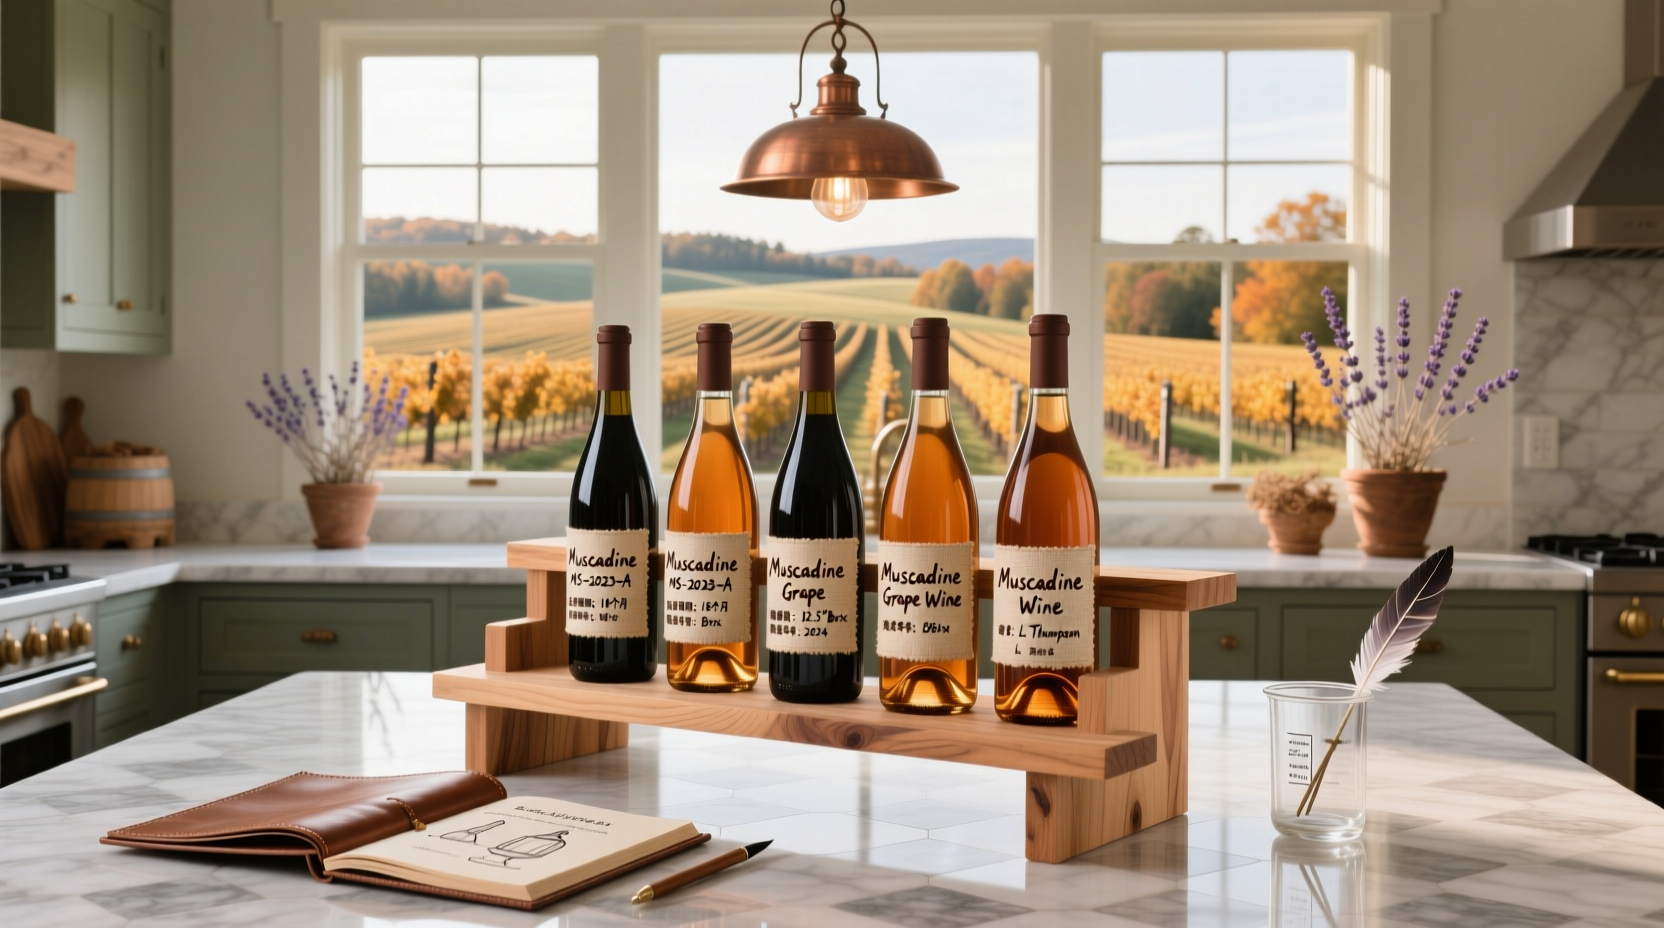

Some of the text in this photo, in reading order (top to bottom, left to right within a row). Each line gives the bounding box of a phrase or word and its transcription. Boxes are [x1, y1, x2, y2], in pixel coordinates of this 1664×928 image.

[569, 547, 637, 567] Muscadine
[666, 550, 738, 571] Muscadine
[769, 557, 845, 578] Muscadine
[881, 562, 961, 584] Muscadine
[998, 567, 1083, 590] Muscadine
[782, 582, 826, 607] Grape
[883, 586, 961, 614] Grape Wine
[1020, 595, 1063, 615] Wine
